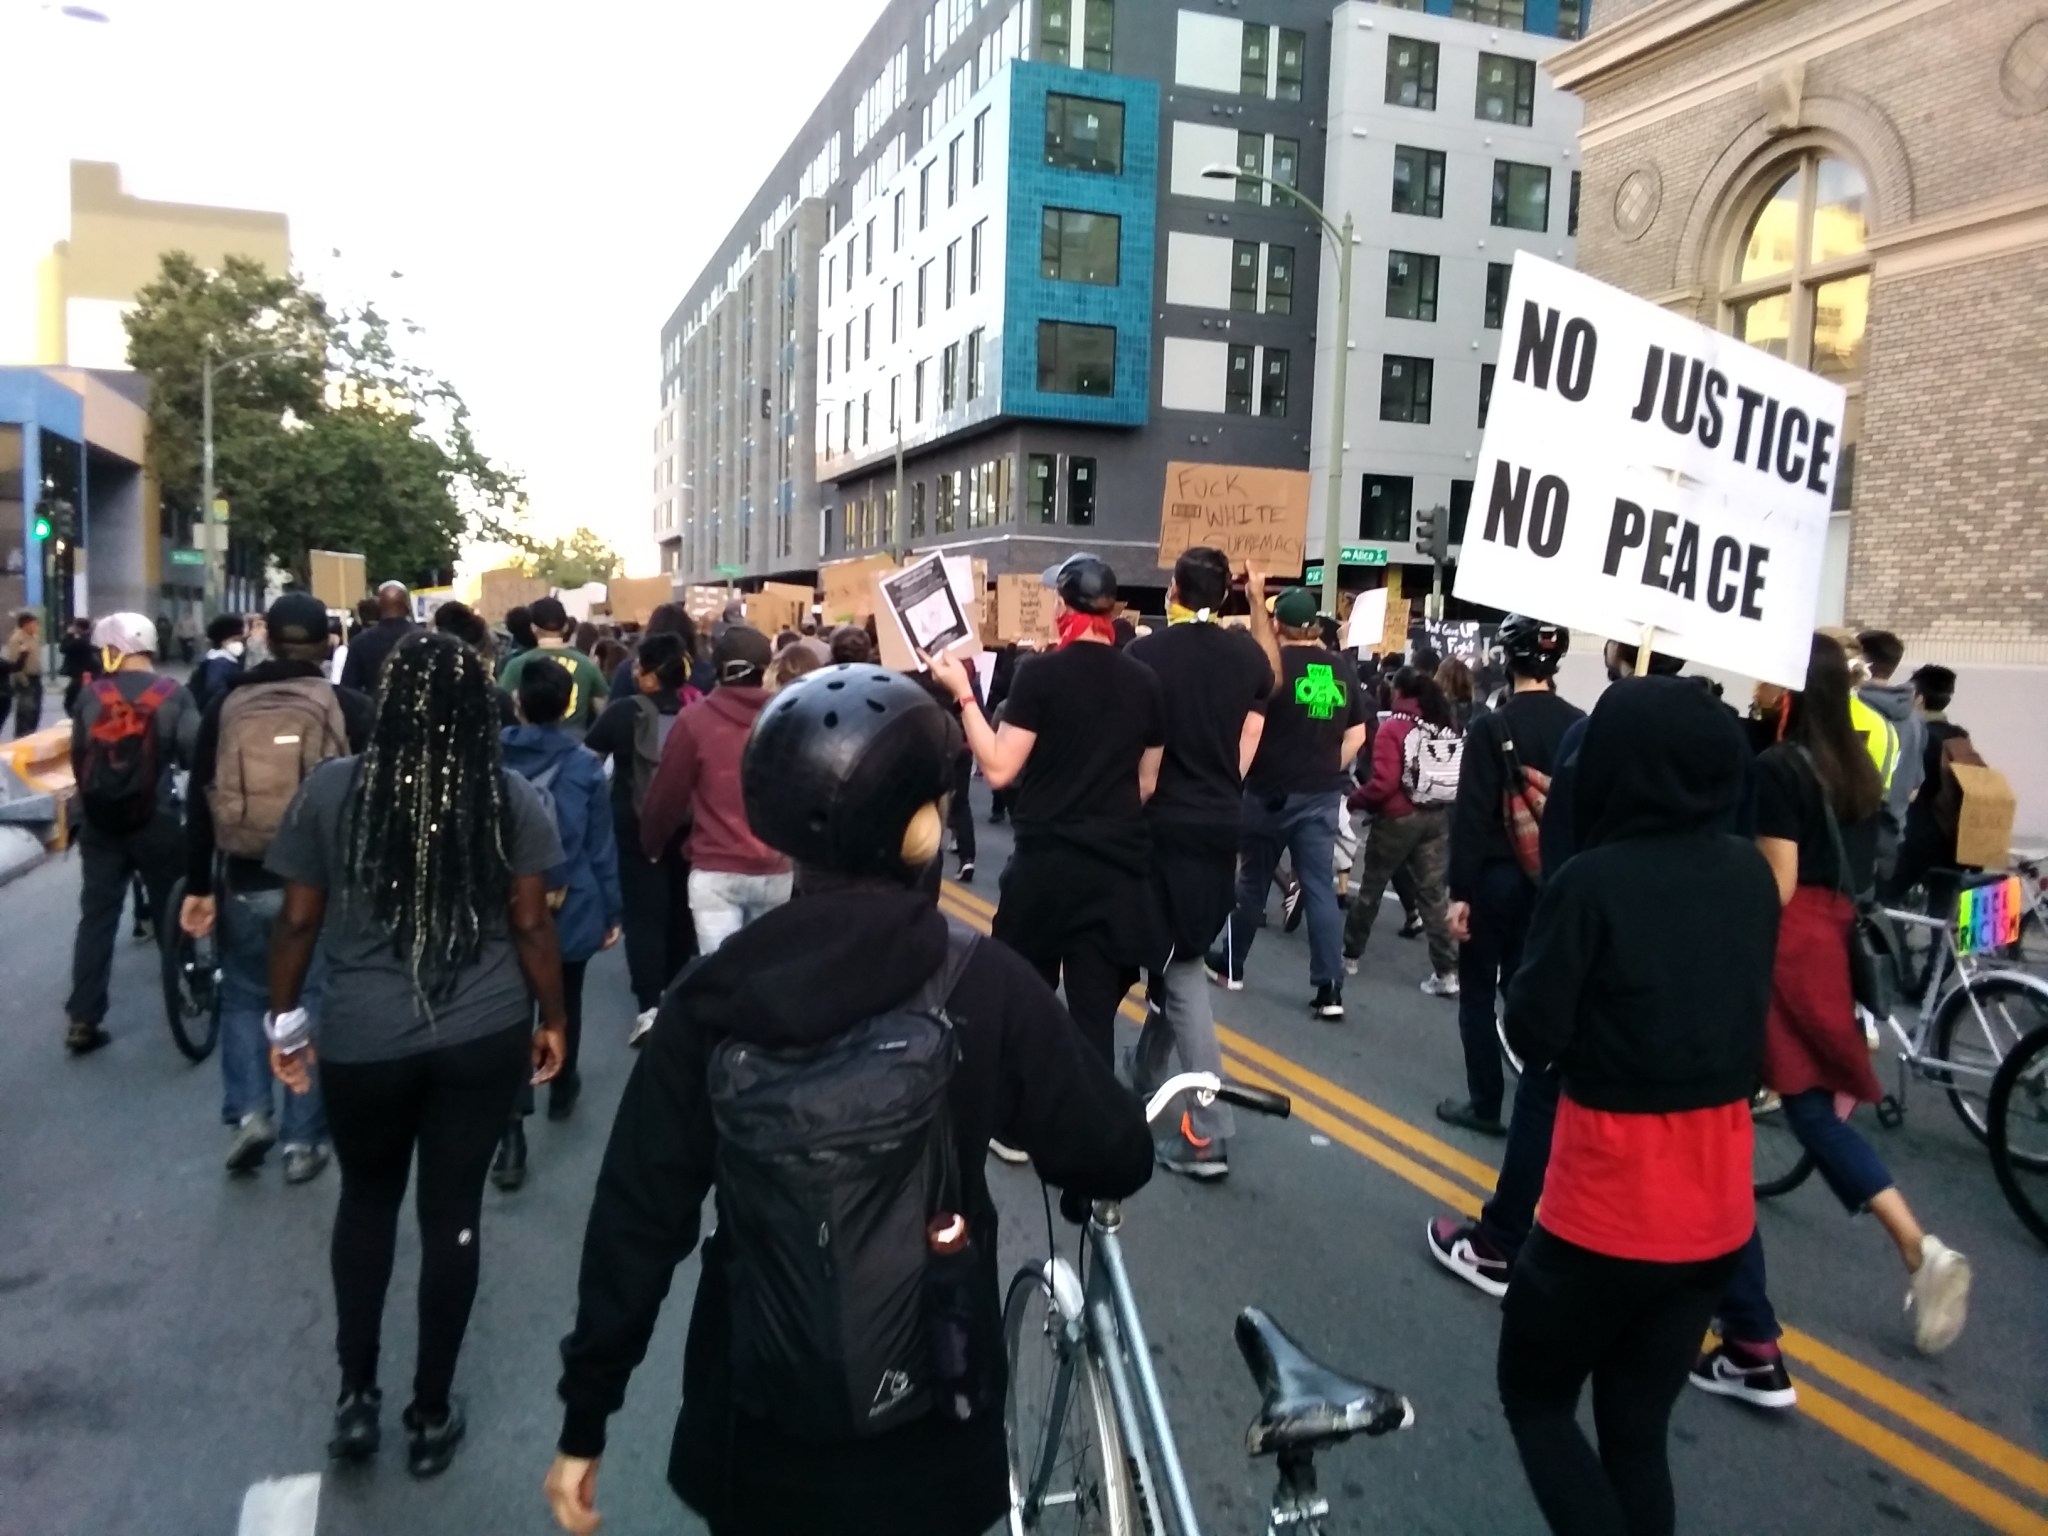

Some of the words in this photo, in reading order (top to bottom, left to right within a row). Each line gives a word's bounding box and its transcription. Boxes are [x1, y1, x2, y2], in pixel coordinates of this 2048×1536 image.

[1513, 299, 1598, 402] NO
[1631, 344, 1836, 496] JUSTICE
[1178, 465, 1249, 499] FUCK
[1205, 503, 1287, 528] WHITE
[1482, 459, 1570, 559] NO
[1601, 497, 1770, 621] PEACE
[1459, 621, 1480, 638] UP
